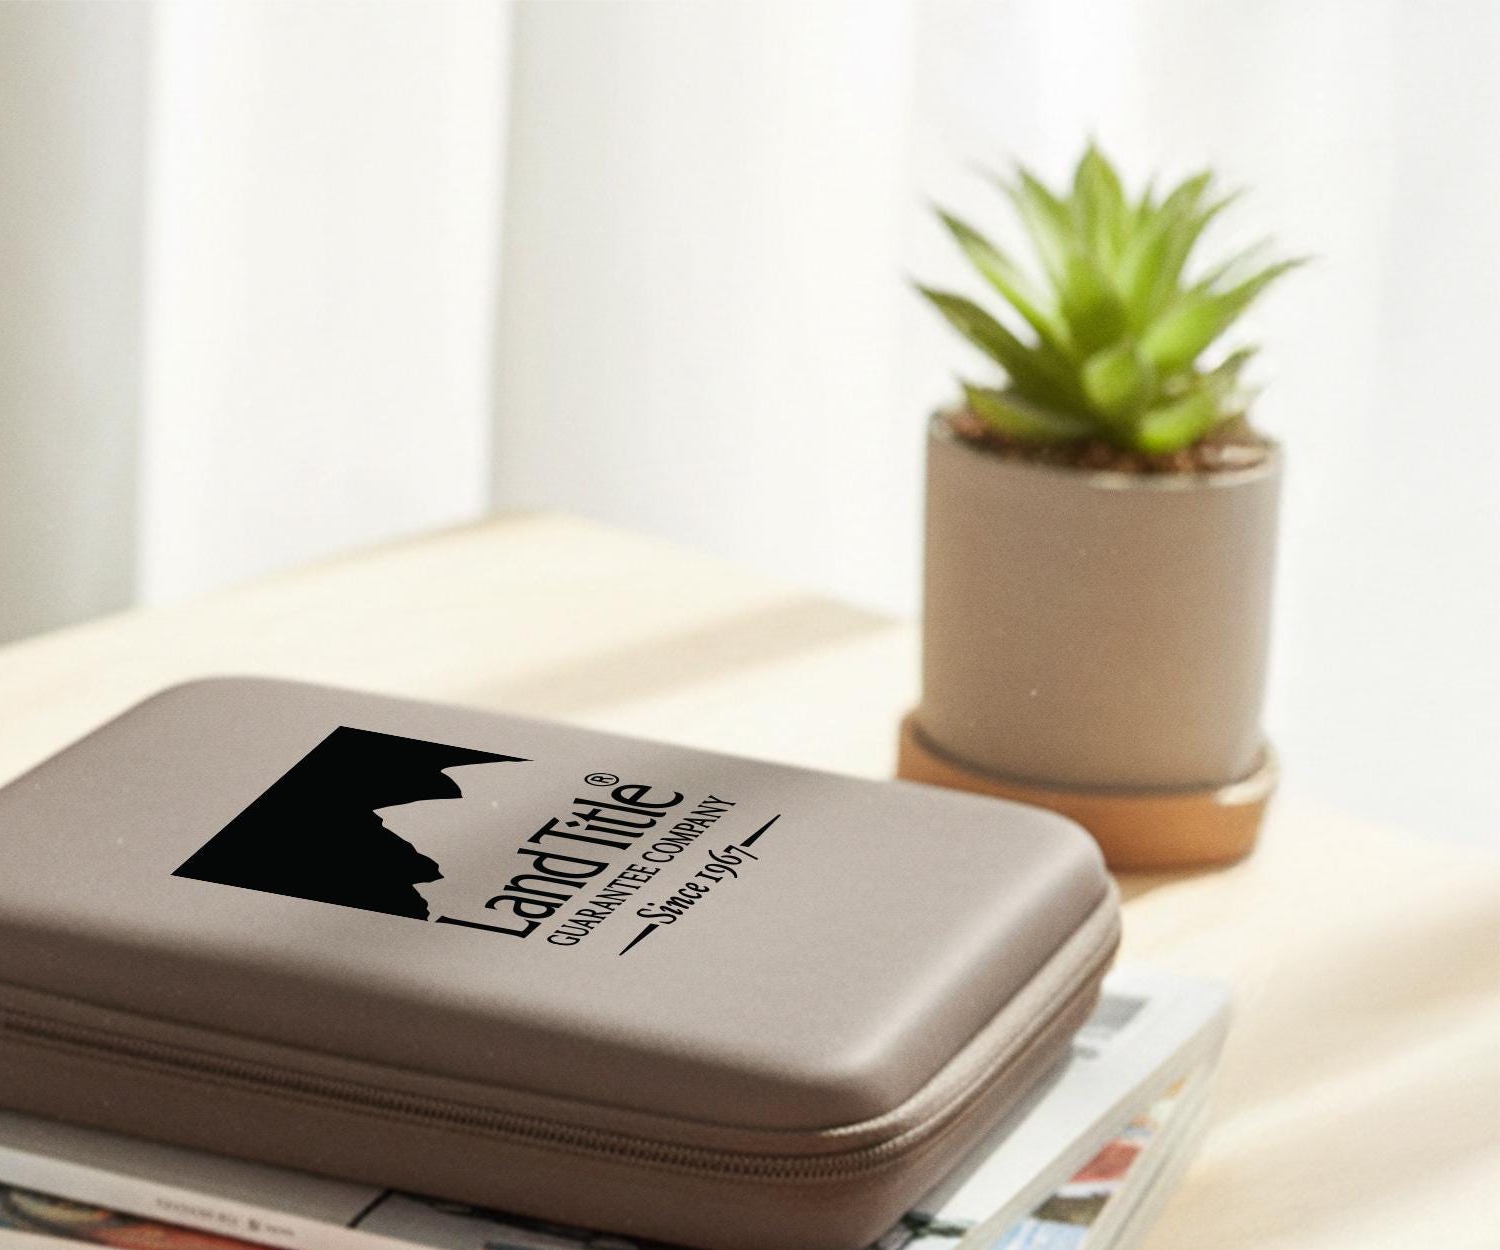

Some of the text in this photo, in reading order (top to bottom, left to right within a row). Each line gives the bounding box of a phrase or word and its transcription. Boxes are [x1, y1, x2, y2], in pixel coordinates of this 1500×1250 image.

[434, 847, 610, 939] Land
[546, 794, 736, 946] GUARANTEE COMPANY
[636, 844, 759, 925] Since 1967
